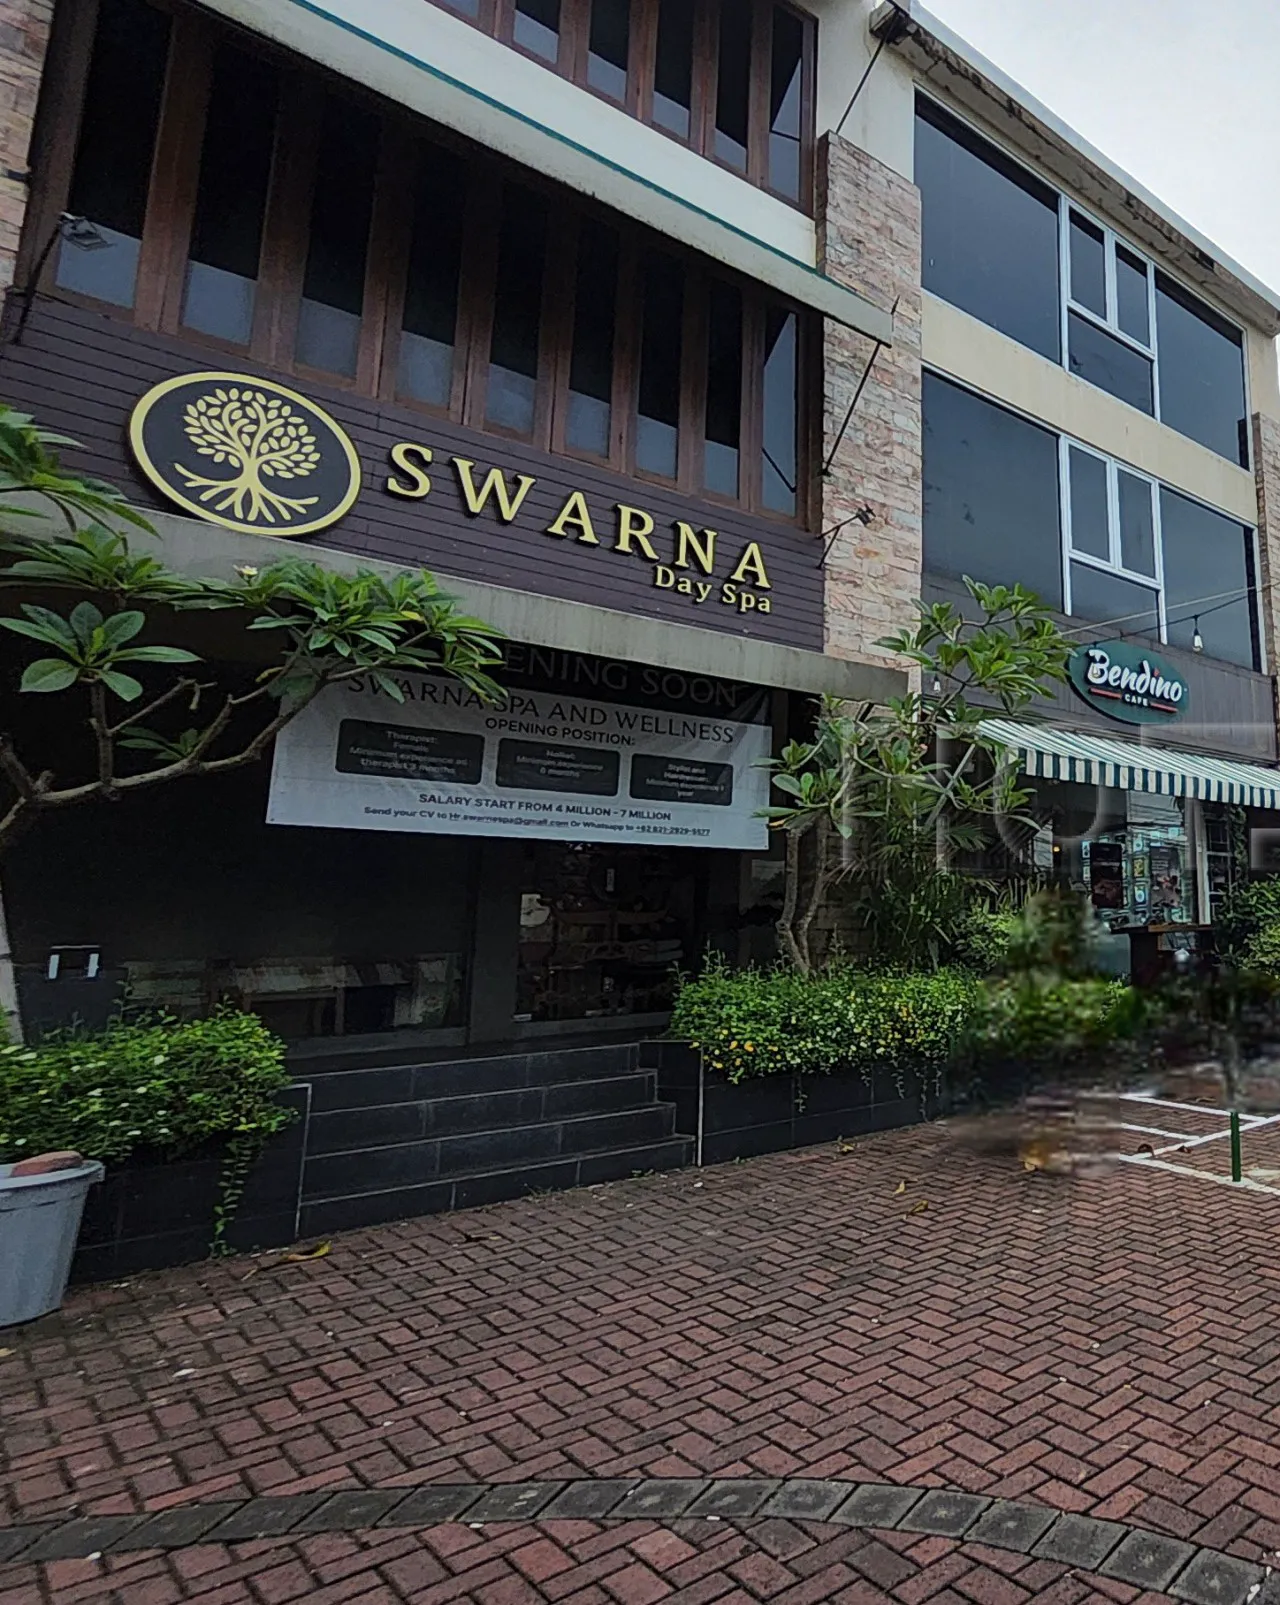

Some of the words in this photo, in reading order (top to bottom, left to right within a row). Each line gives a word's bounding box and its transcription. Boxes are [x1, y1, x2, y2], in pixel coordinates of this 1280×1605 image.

[386, 441, 773, 590] SWARNA
[655, 564, 713, 604] Day
[721, 582, 773, 614] Spa
[640, 668, 738, 708] SOON
[1087, 649, 1183, 702] Bendino
[493, 692, 540, 717] SPA
[548, 702, 608, 726] AND
[615, 711, 735, 744] WELLNESS
[1124, 693, 1149, 707] CAFE
[485, 717, 559, 738] OPENING
[562, 726, 636, 746] POSITION:
[364, 806, 392, 816] Send
[393, 809, 417, 818] your
[419, 809, 435, 819] CV
[436, 811, 447, 819] to
[419, 793, 473, 808] SALARY
[474, 798, 517, 810] START
[517, 802, 553, 813] FROM
[555, 803, 563, 813] 4
[566, 805, 611, 817] MILLION
[620, 809, 627, 818] 7
[629, 810, 672, 821] MILLION
